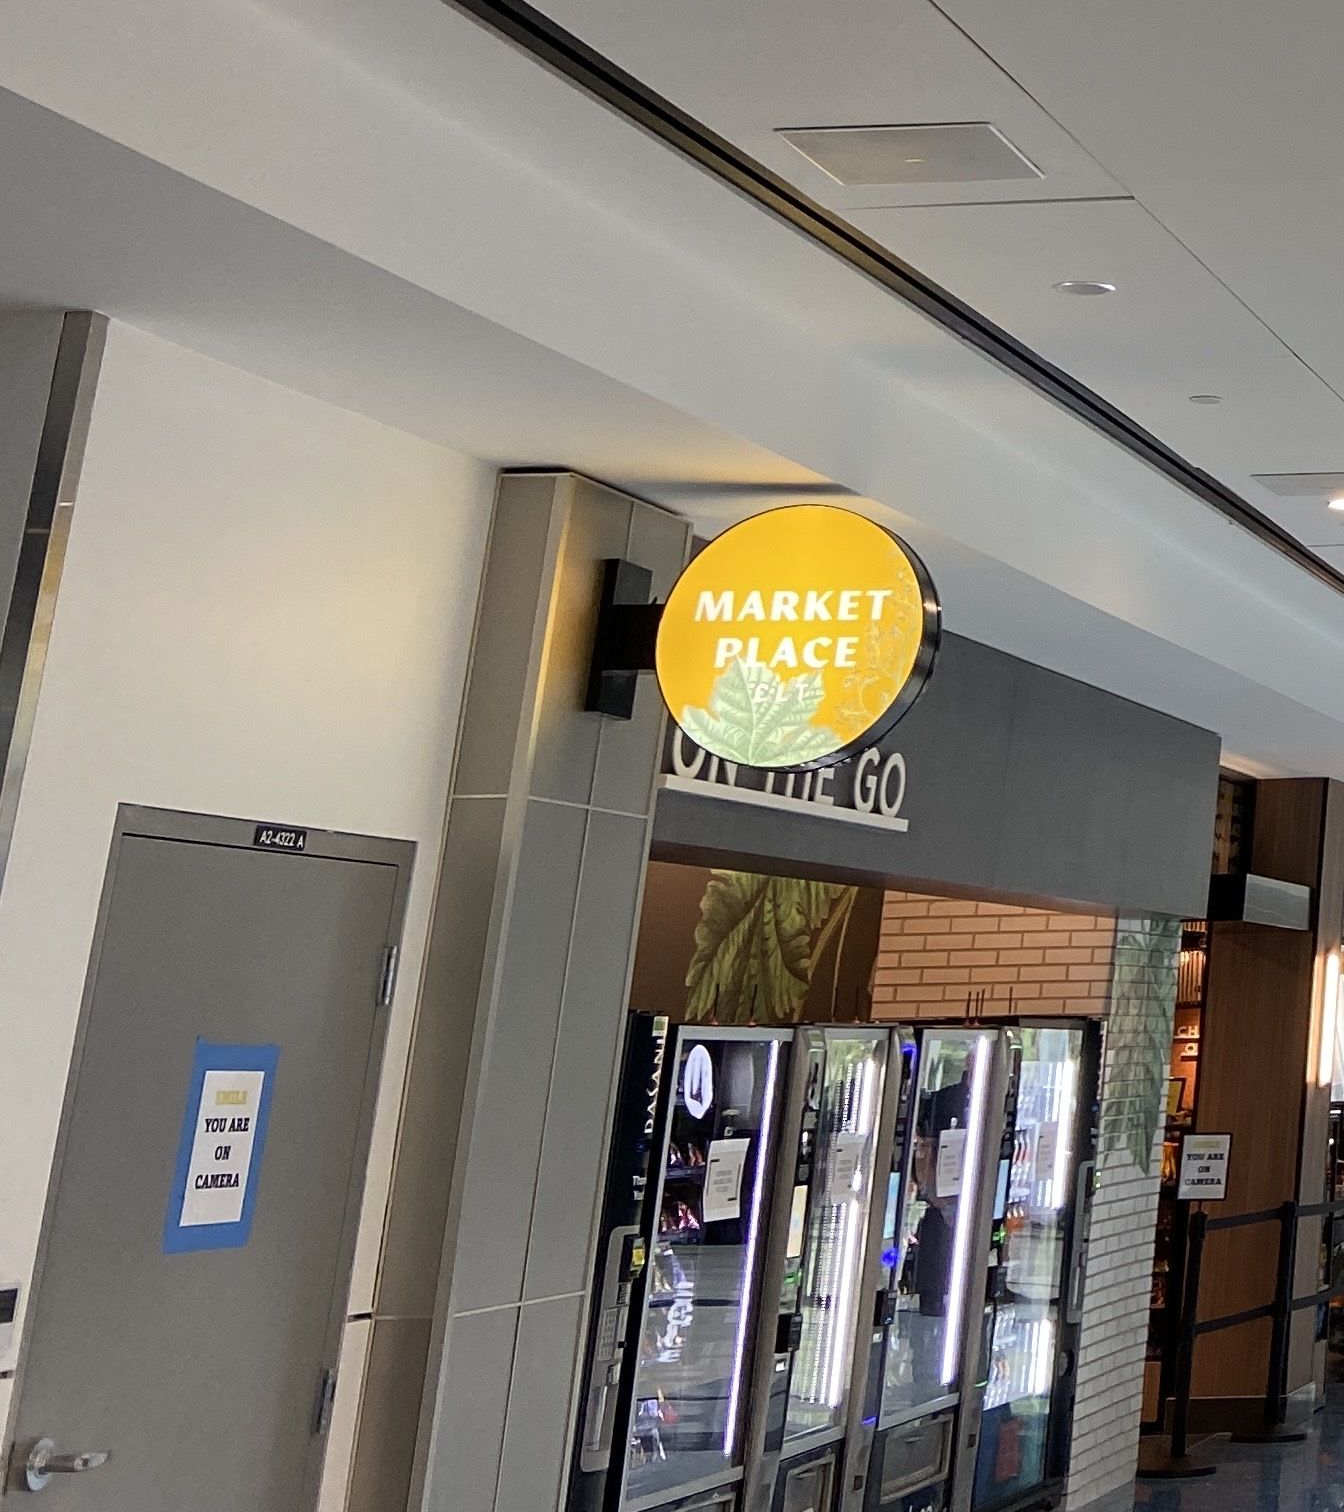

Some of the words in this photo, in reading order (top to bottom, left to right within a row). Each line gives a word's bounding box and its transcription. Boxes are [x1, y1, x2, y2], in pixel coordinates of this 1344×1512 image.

[693, 589, 894, 623] MARKET
[713, 635, 861, 669] PLACE
[853, 746, 907, 818] GO
[259, 830, 296, 846] A2-4322
[296, 834, 304, 849] A
[204, 1118, 227, 1133] YOU
[228, 1117, 250, 1132] ARE
[214, 1145, 232, 1160] ON
[1187, 1153, 1206, 1161] YOU
[194, 1173, 240, 1189] CAMERA
